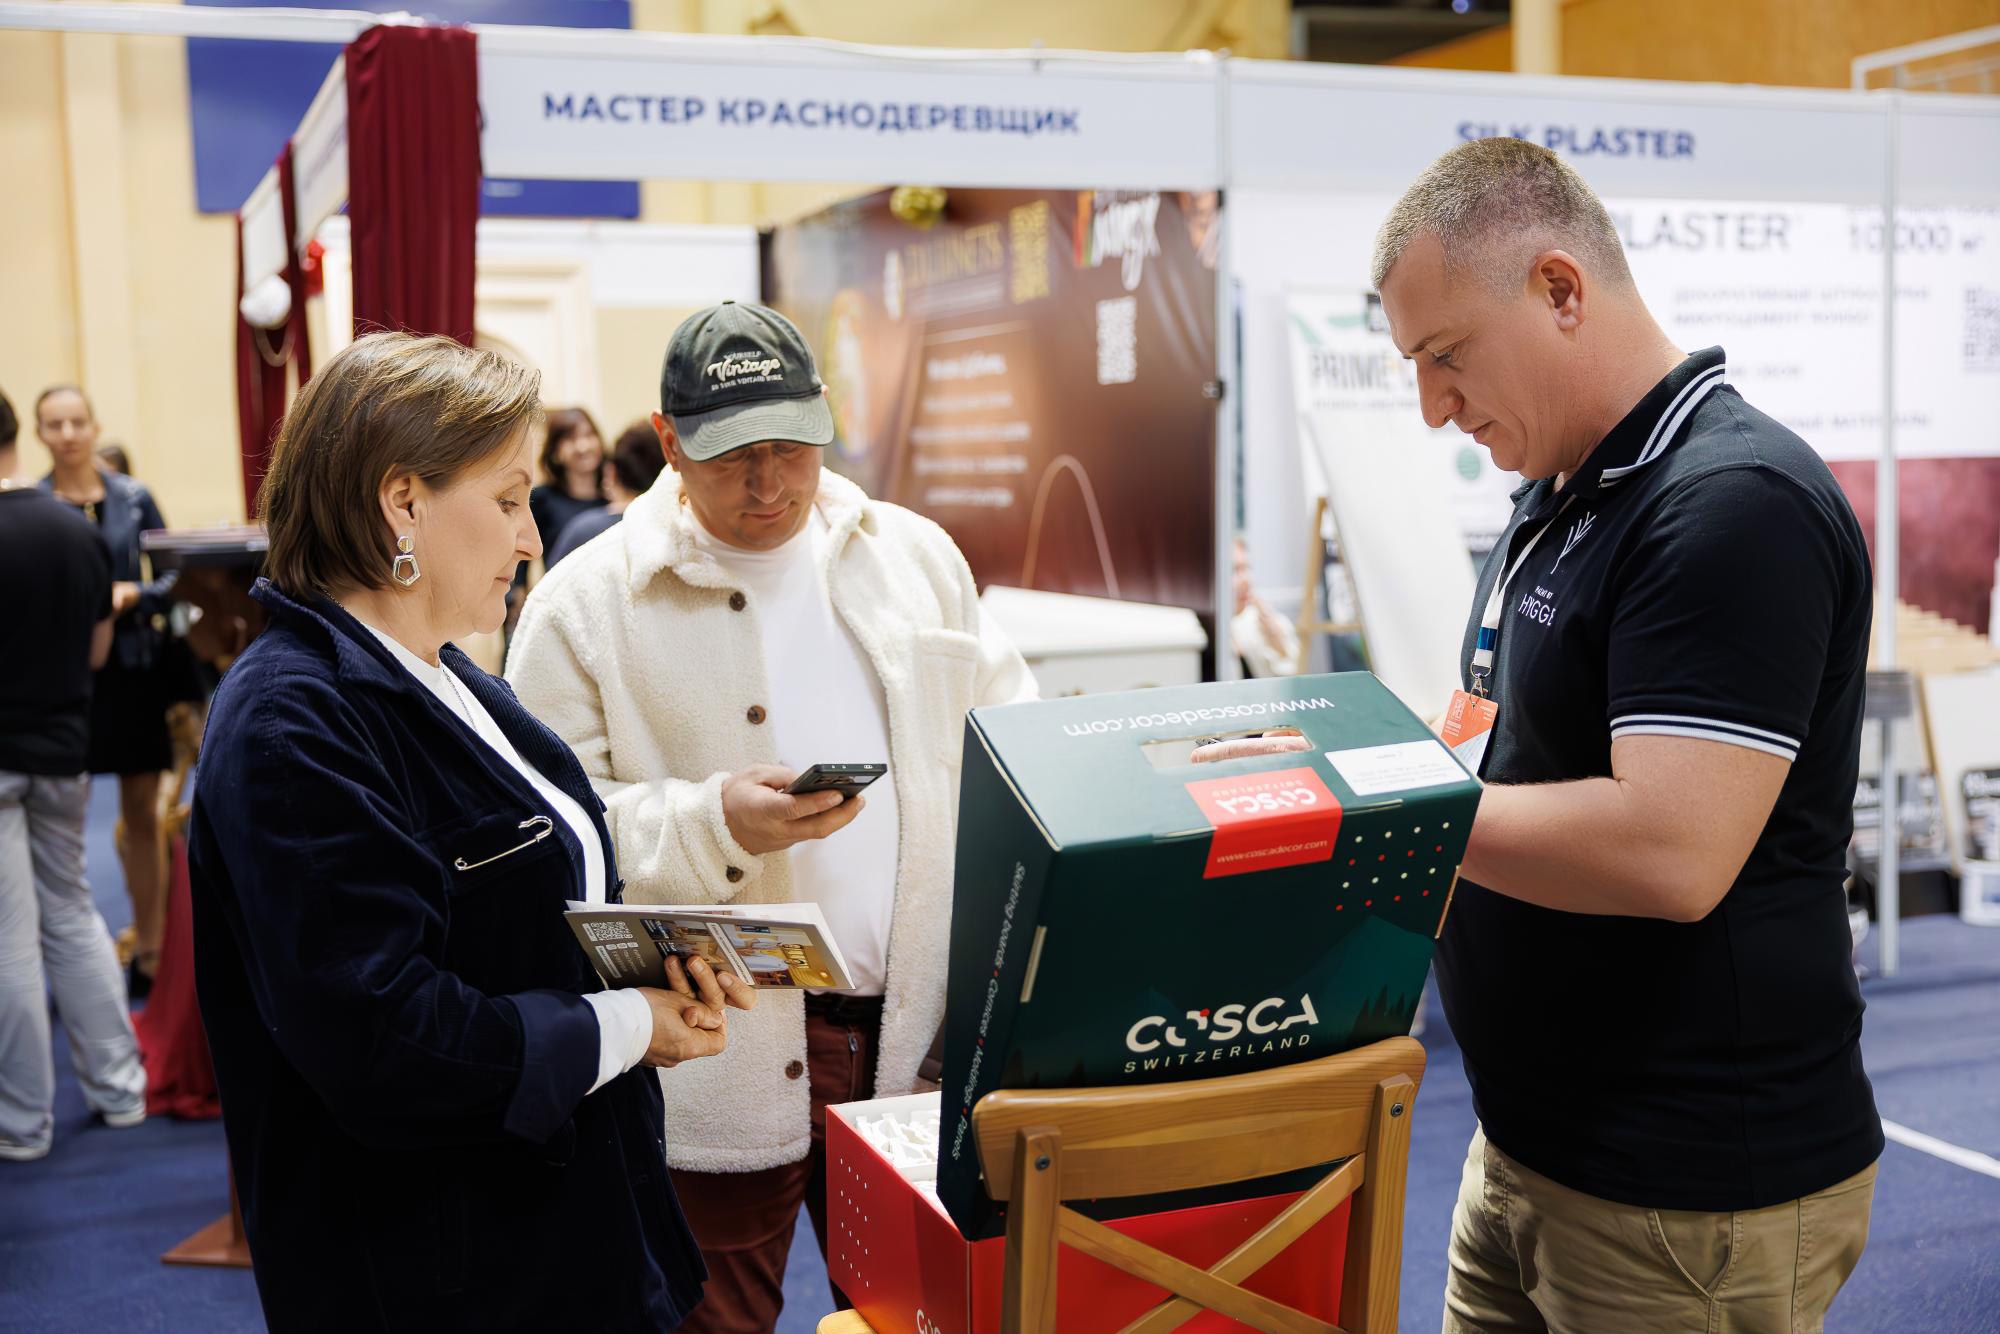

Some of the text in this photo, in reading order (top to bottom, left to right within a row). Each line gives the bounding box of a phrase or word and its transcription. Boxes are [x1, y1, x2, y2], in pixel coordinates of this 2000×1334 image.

[544, 93, 1081, 136] МАСТЕР КРАСНОДЕРЕВЩИК
[1545, 126, 1696, 158] PLASTER
[1614, 210, 1791, 252] LASTER
[707, 358, 781, 382] Vintage
[1062, 697, 1335, 737] www.coscadecor.com
[1216, 839, 1328, 863] www.coscadecor.com
[952, 861, 1026, 1161] Skirting boards Cornices Moldings Panels
[1125, 992, 1320, 1053] COSCA
[1124, 1033, 1311, 1073] SWITZERLAND
